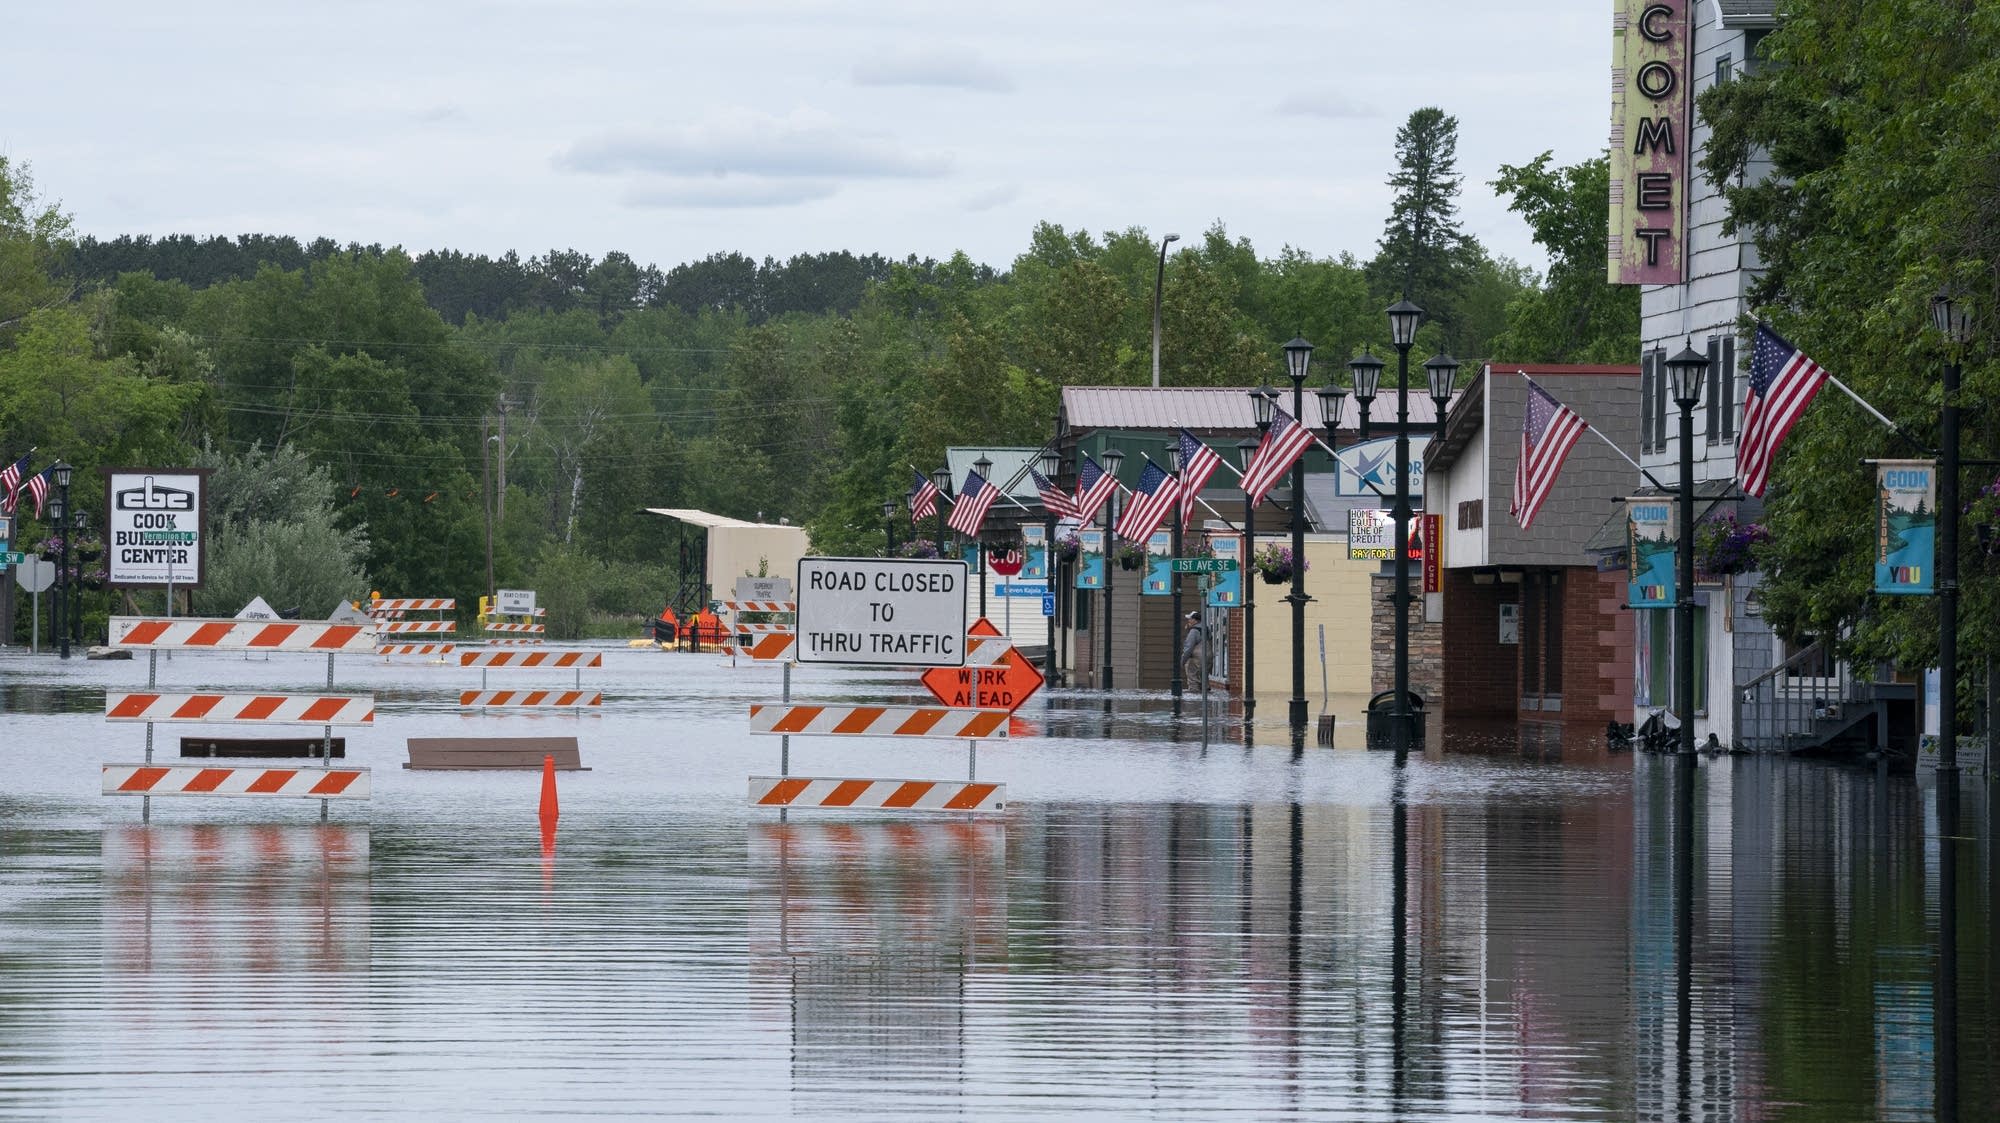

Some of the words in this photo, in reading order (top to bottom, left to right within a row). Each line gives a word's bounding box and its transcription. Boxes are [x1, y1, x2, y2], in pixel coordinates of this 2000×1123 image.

[1634, 3, 1676, 266] COMET
[1886, 471, 1929, 488] COOK
[1351, 510, 1373, 518] HOME
[1632, 506, 1668, 520] COOK
[133, 513, 177, 529] COOK
[1881, 489, 1890, 564] WELCOMES
[144, 532, 179, 541] Vermilion
[1351, 527, 1371, 535] LINE
[1373, 527, 1384, 535] OF
[1351, 535, 1383, 543] CREDIT
[5, 554, 18, 563] SW
[121, 549, 188, 564] CENTER
[1371, 549, 1387, 559] FOR
[1179, 560, 1194, 571] 1ST
[1196, 560, 1213, 571] AVE
[1217, 560, 1229, 571] SE
[810, 571, 867, 591] ROAD
[874, 572, 954, 593] CLOSED
[1890, 566, 1921, 584] YOU
[1216, 592, 1233, 602] YOU
[1640, 585, 1665, 600] YOU
[869, 603, 894, 622] TO
[808, 632, 862, 653] THRU
[870, 633, 953, 654] TRAFFIC
